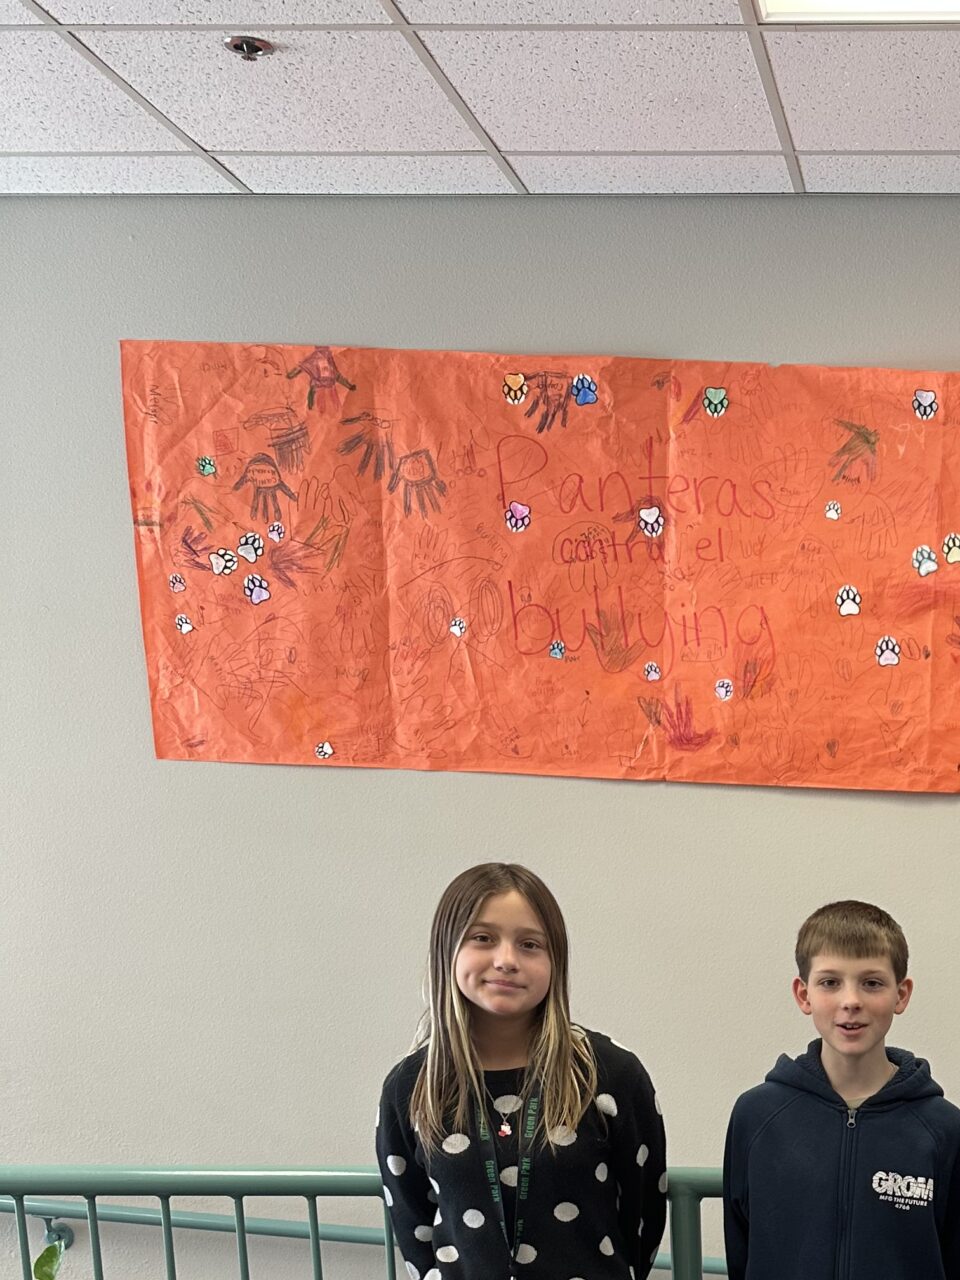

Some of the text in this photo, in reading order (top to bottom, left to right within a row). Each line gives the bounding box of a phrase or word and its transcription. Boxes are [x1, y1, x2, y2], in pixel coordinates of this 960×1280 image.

[496, 434, 776, 520] Panteras
[695, 527, 726, 563] el
[507, 580, 777, 682] bullying
[524, 1097, 539, 1139] Green Park
[489, 1183, 500, 1203] Park
[520, 1156, 531, 1200] Green Park
[872, 1170, 934, 1201] GROM
[879, 1194, 928, 1207] MFG THE FUTURE
